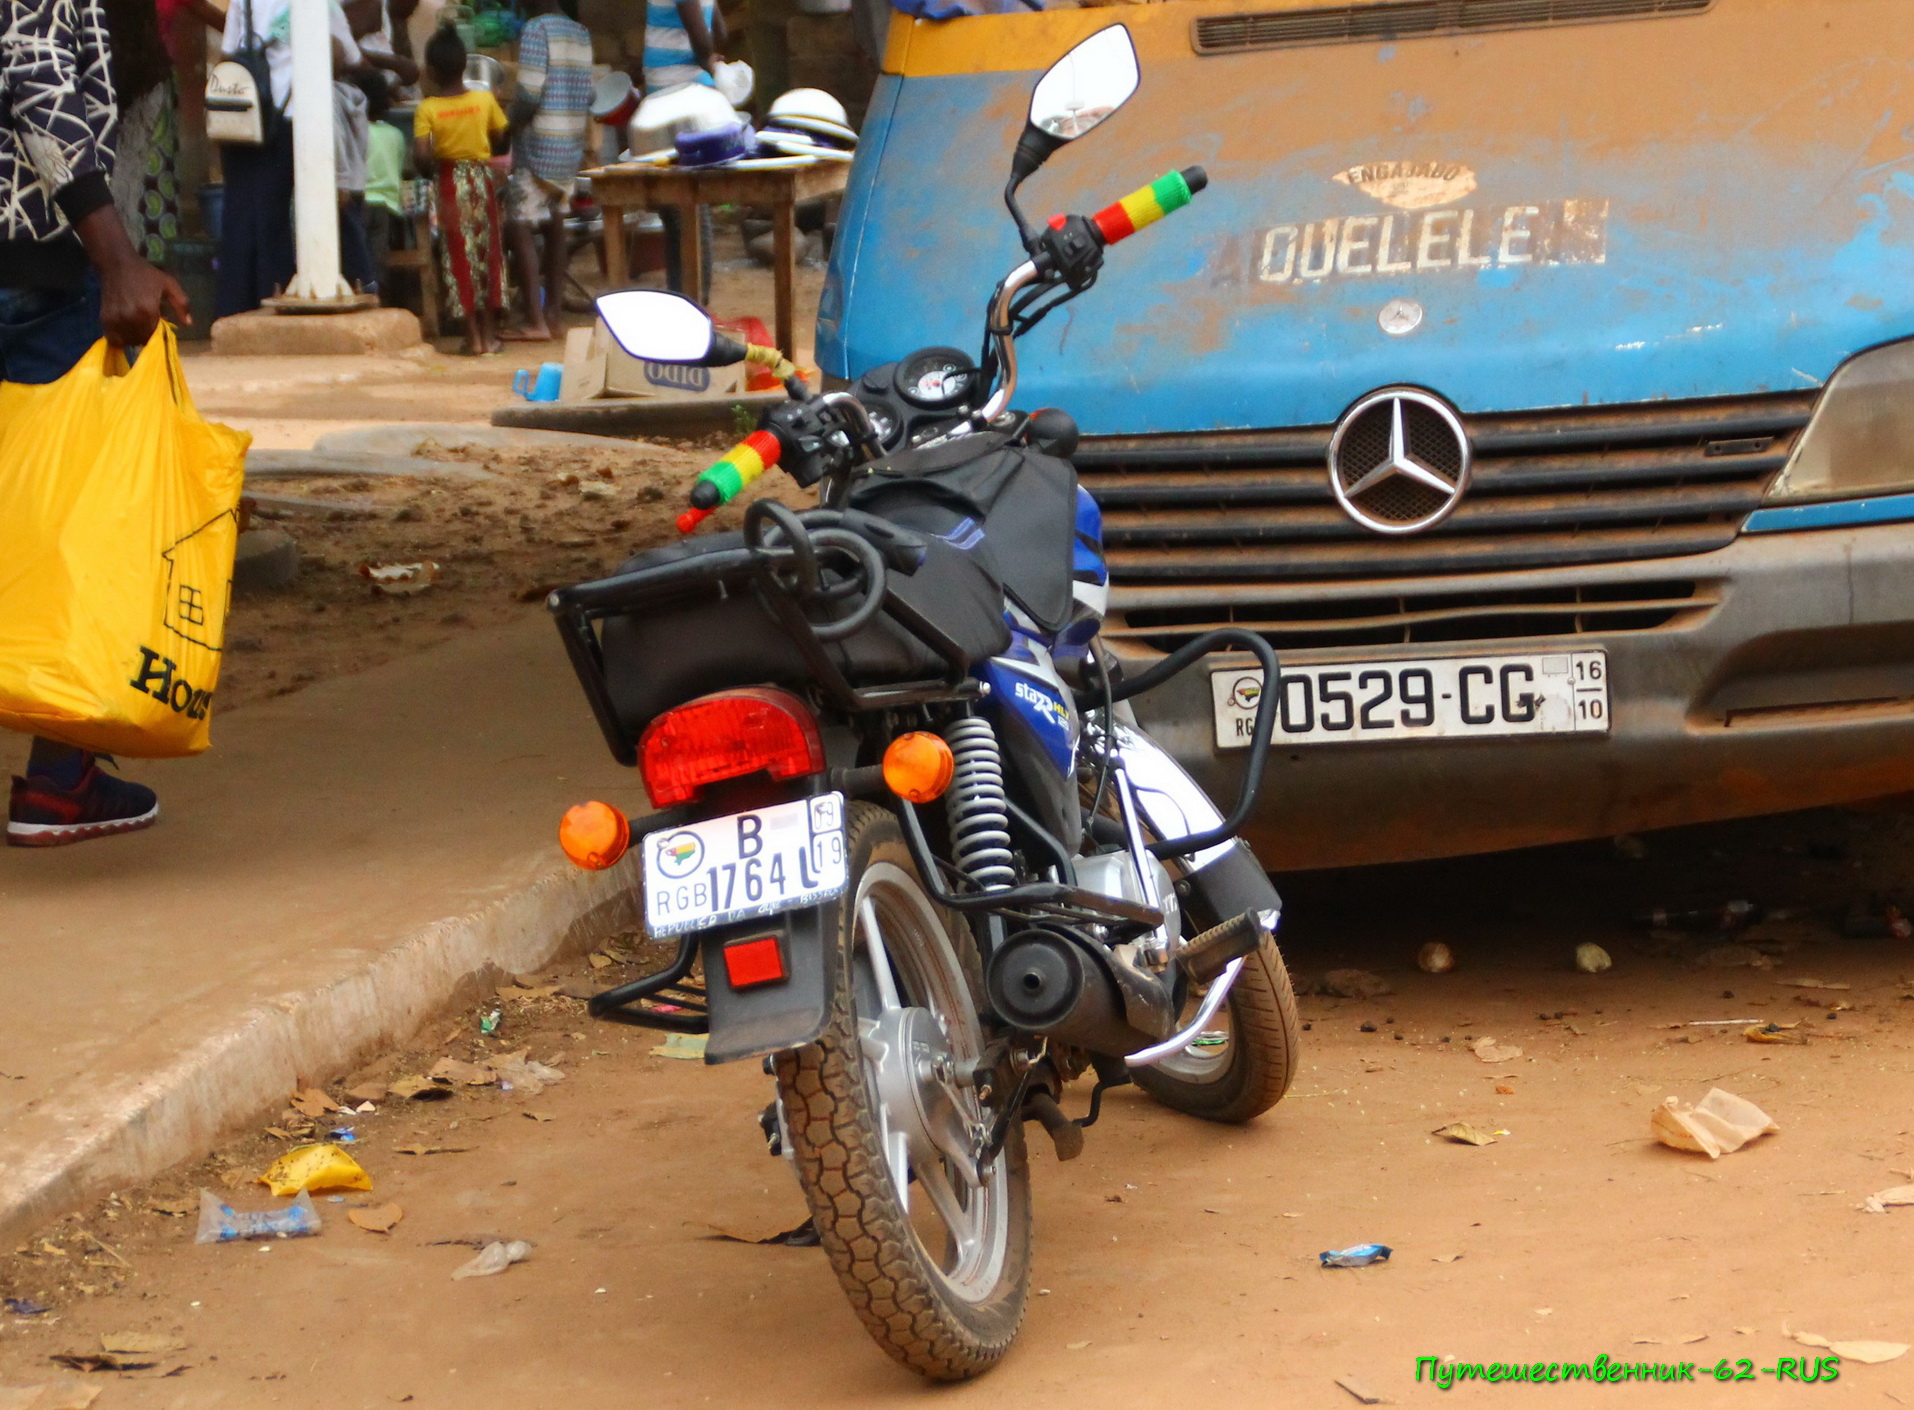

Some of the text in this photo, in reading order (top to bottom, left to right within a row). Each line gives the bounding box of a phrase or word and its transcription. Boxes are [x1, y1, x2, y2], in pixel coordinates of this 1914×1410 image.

[1576, 660, 1602, 681] 16
[1280, 663, 1535, 733] 0529-CG
[1578, 698, 1603, 720] 10
[1236, 716, 1256, 737] RG
[736, 814, 763, 860] B
[816, 836, 842, 869] 19
[706, 852, 786, 912] 1764
[657, 882, 707, 917] RGB
